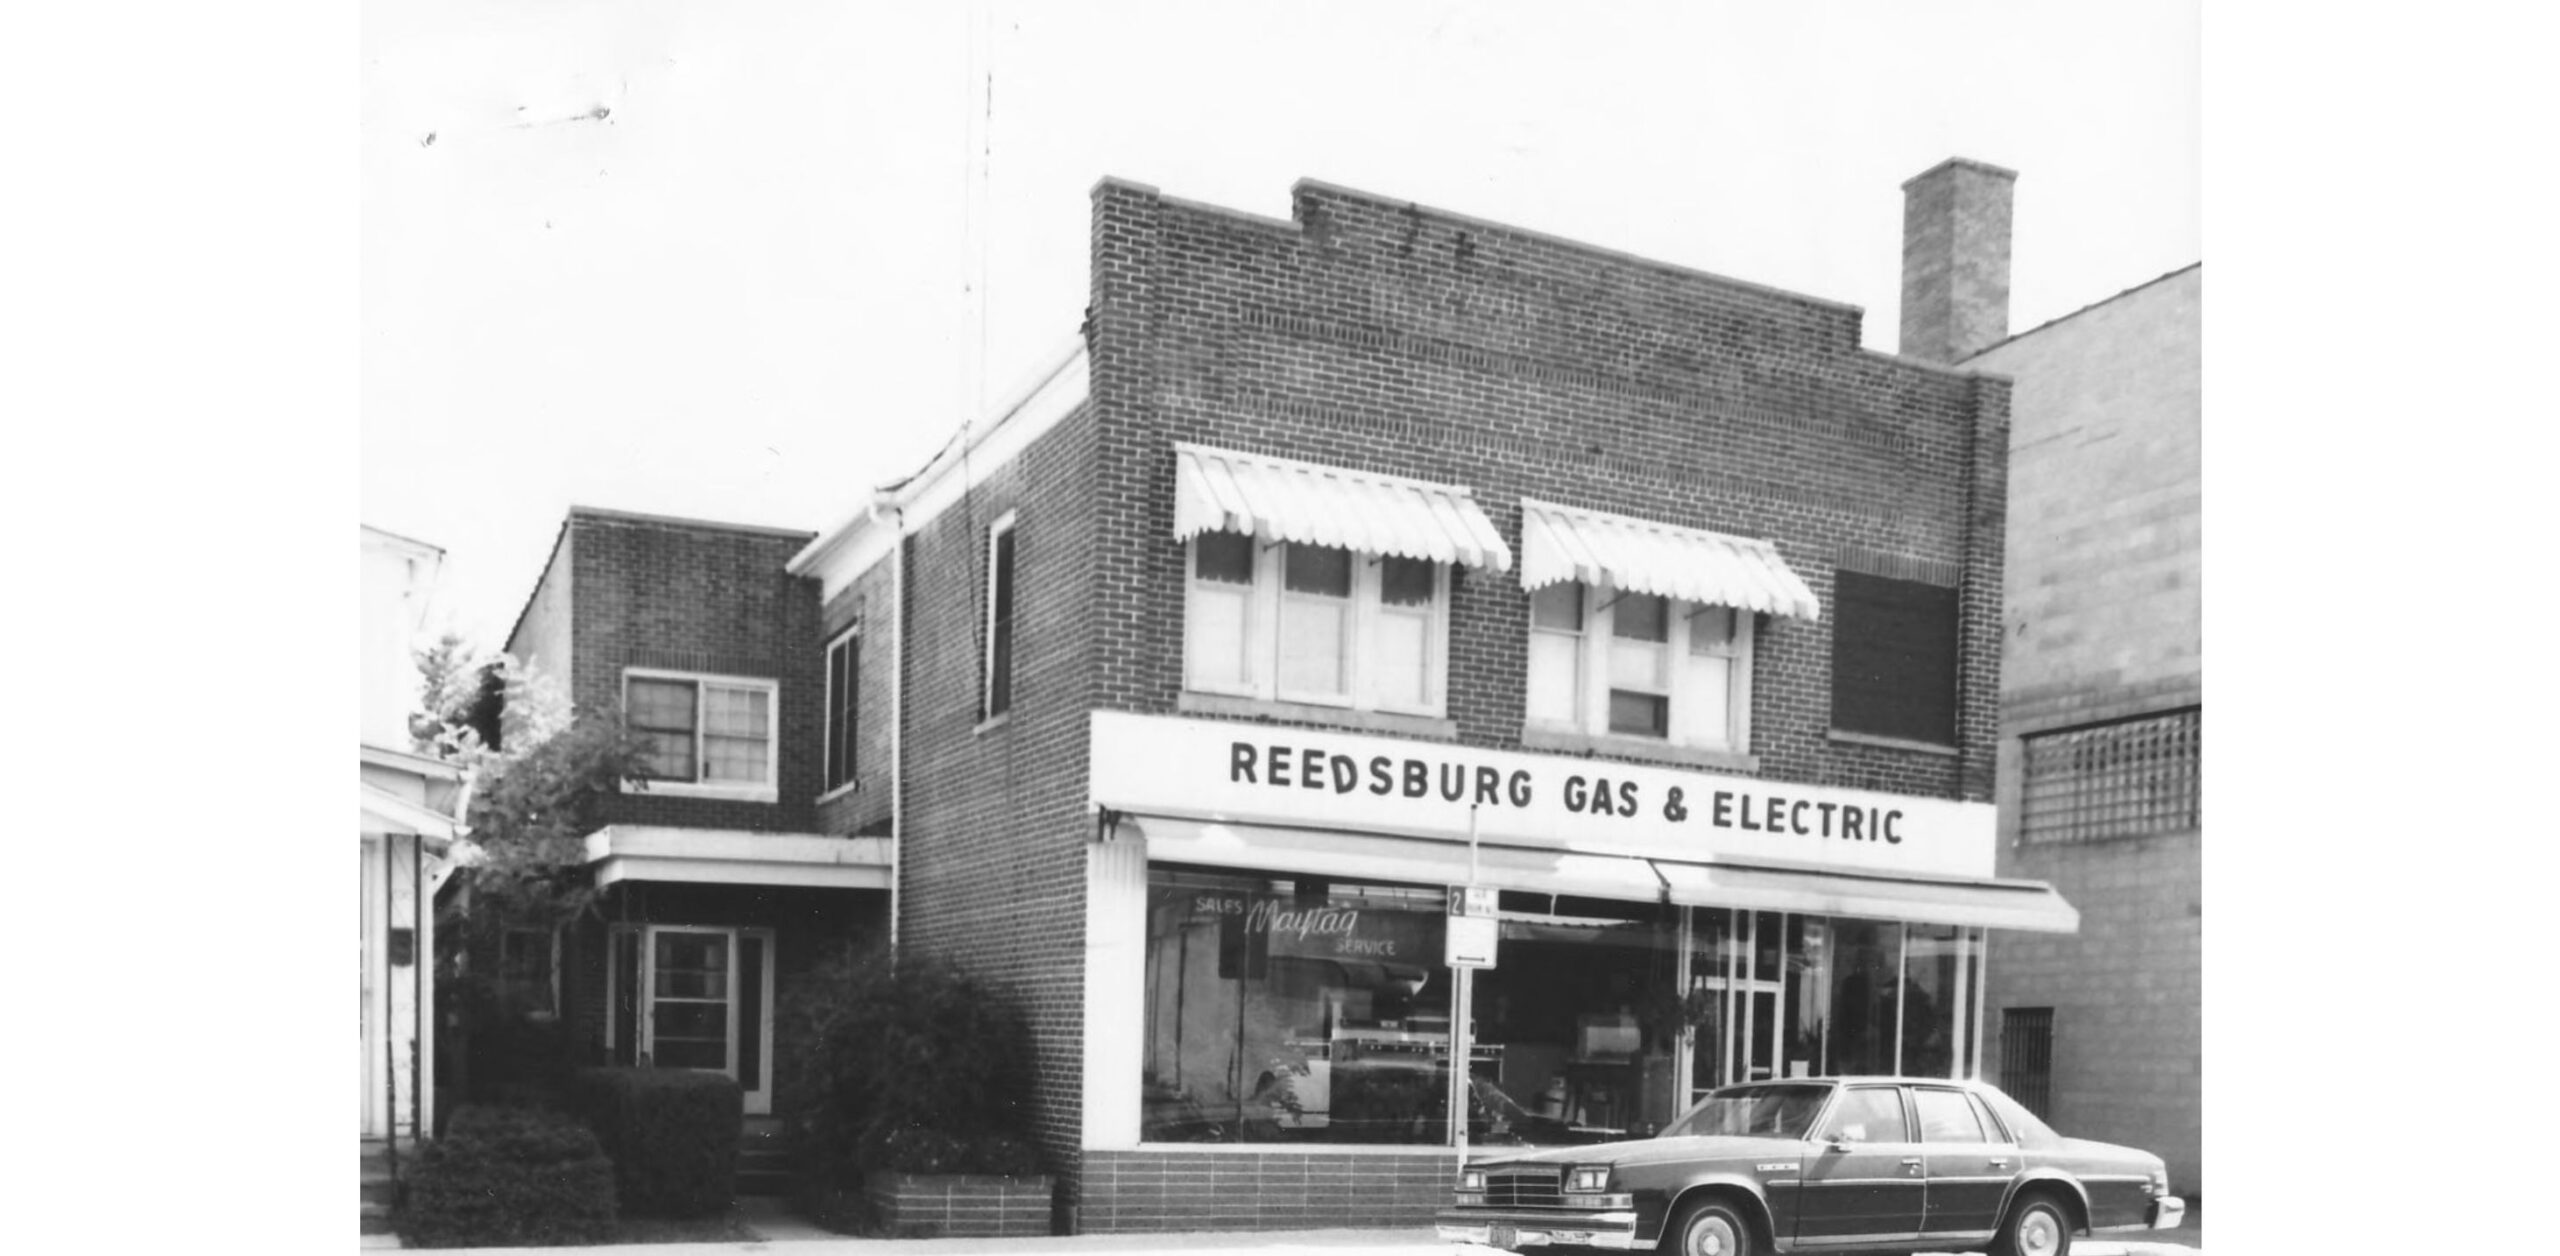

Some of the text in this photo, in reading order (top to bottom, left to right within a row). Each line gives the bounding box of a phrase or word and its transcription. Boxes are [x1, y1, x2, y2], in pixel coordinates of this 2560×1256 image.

[1231, 742, 1904, 844] REEDSBURG GAS & ELECTRIC
[1195, 897, 1243, 915] SALES
[1451, 891, 1462, 914] 2
[1244, 899, 1359, 941] Maytag
[1335, 936, 1397, 956] SERVICE
